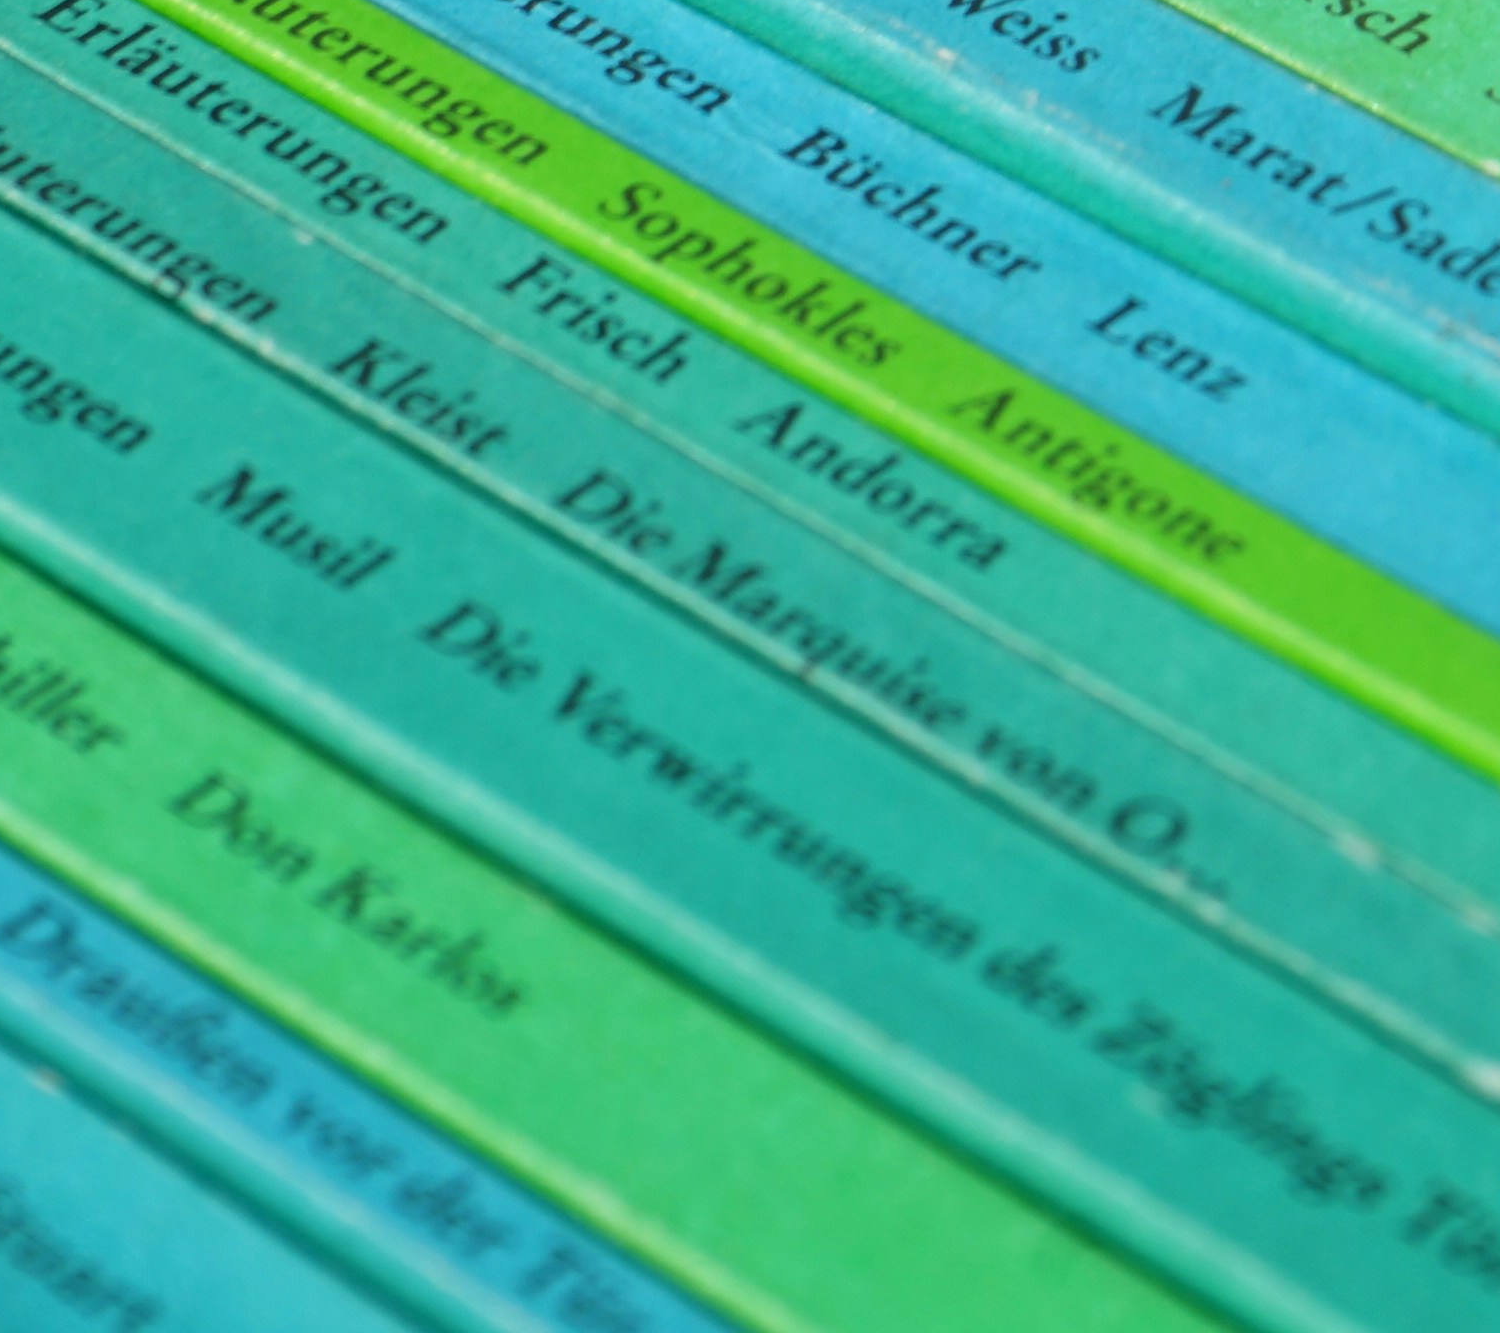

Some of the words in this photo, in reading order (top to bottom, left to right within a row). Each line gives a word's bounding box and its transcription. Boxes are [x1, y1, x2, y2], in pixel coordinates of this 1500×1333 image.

[596, 176, 908, 373] Sophokles
[948, 383, 1252, 571] Antigone
[779, 125, 1044, 286] Büchner
[1085, 293, 1252, 403] Lenz
[325, 335, 514, 458] Kleist
[551, 466, 676, 557] Die
[496, 251, 694, 386] Frisch
[731, 397, 1012, 574] Andorra
[191, 459, 402, 595] Musil
[412, 597, 546, 695] Die
[163, 766, 317, 886] Don
